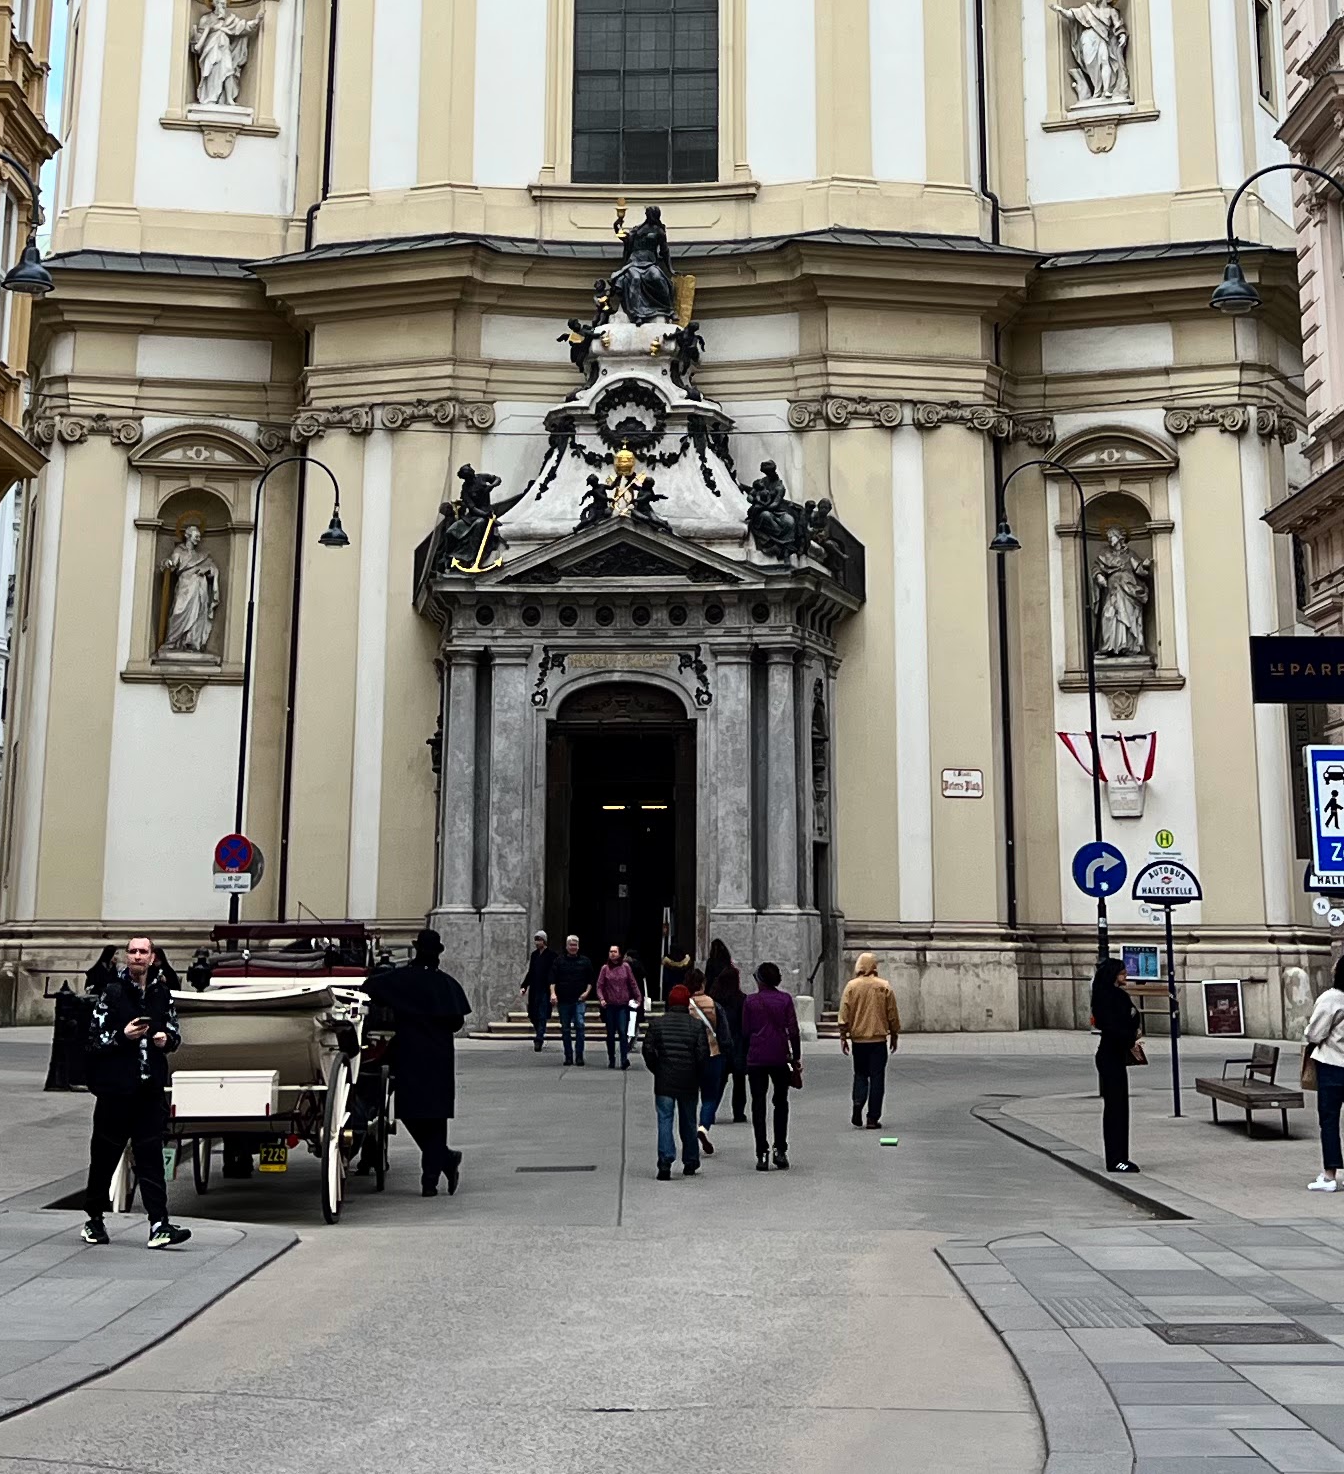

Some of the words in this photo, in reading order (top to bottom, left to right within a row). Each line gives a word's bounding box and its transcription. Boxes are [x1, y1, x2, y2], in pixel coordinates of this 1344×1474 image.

[1270, 663, 1284, 672] LE
[1160, 832, 1170, 845] H
[1147, 866, 1186, 881] AUTOBUS
[1141, 886, 1193, 895] HALTESTELLE
[261, 1147, 286, 1164] F229
